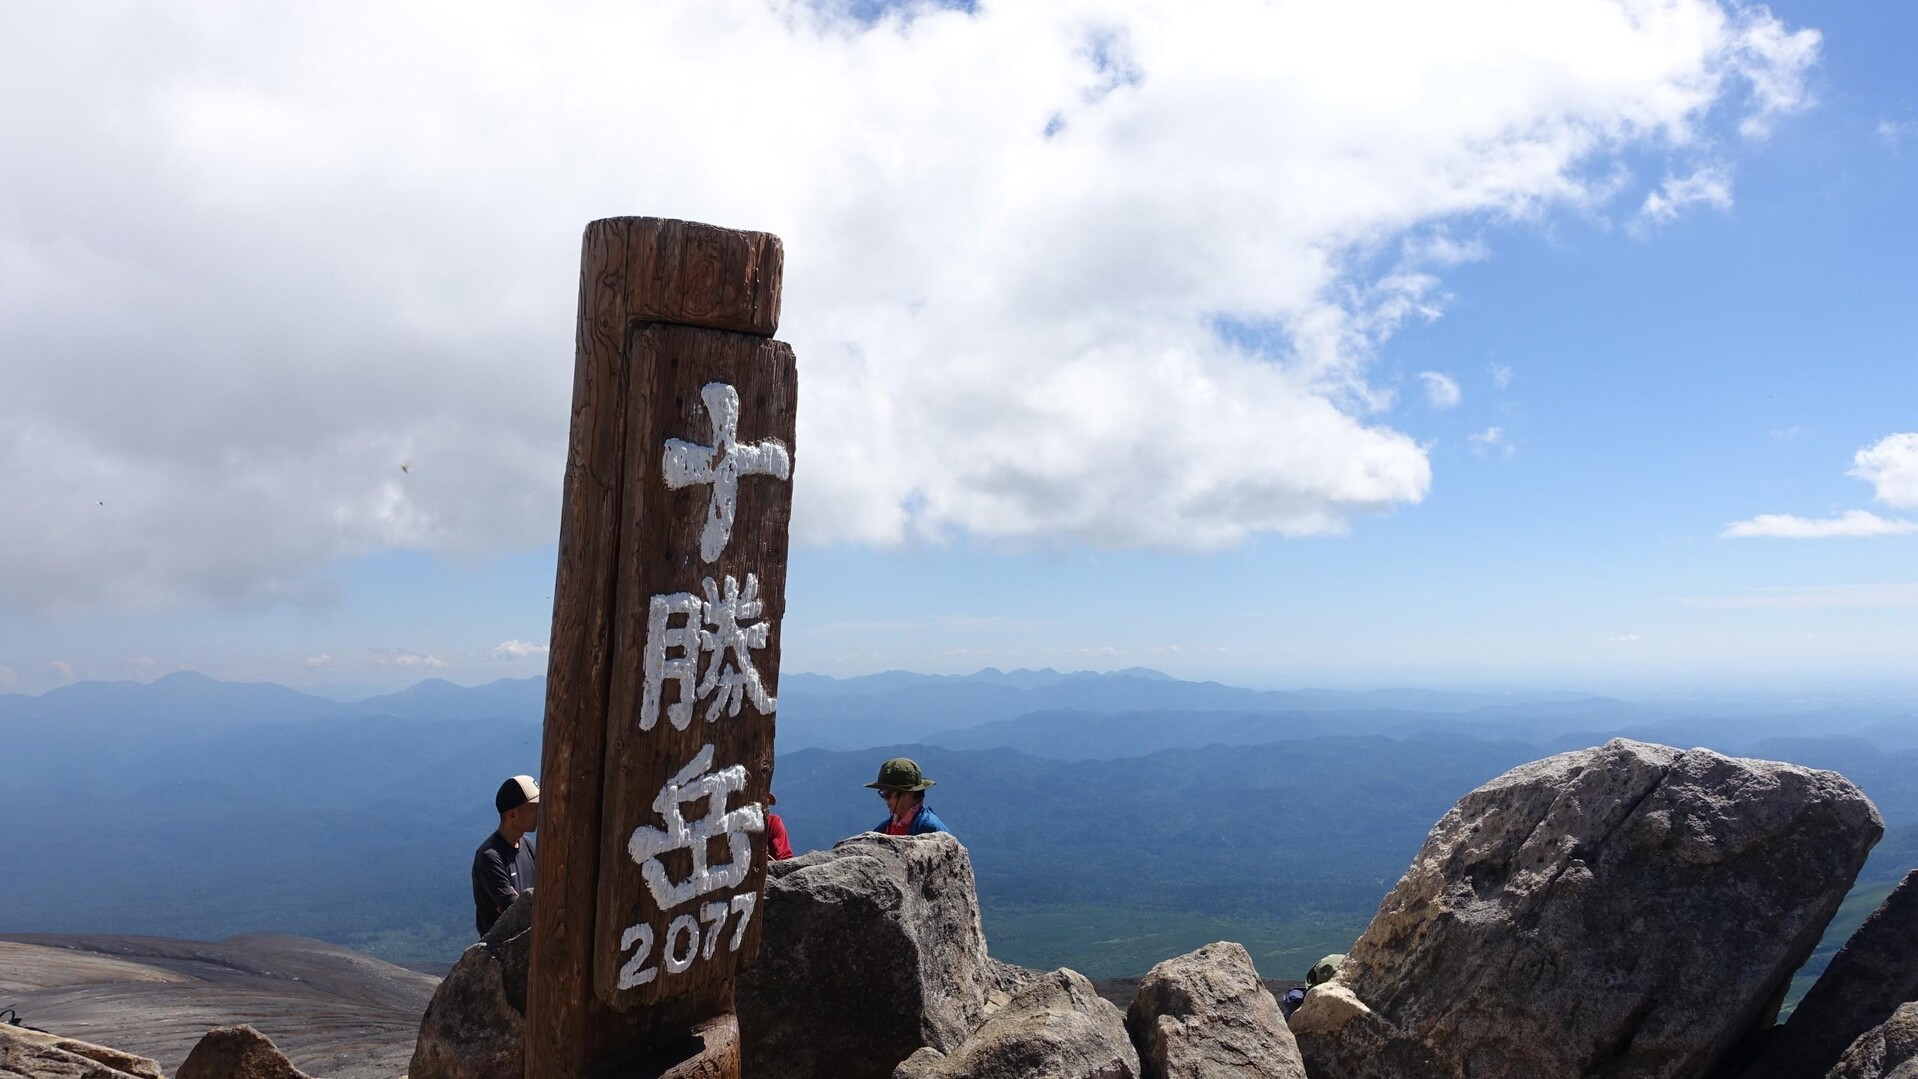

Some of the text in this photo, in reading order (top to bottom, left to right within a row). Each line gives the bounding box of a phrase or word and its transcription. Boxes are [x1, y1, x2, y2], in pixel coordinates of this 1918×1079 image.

[628, 382, 790, 911] 十勝岳
[617, 891, 757, 990] 2077
